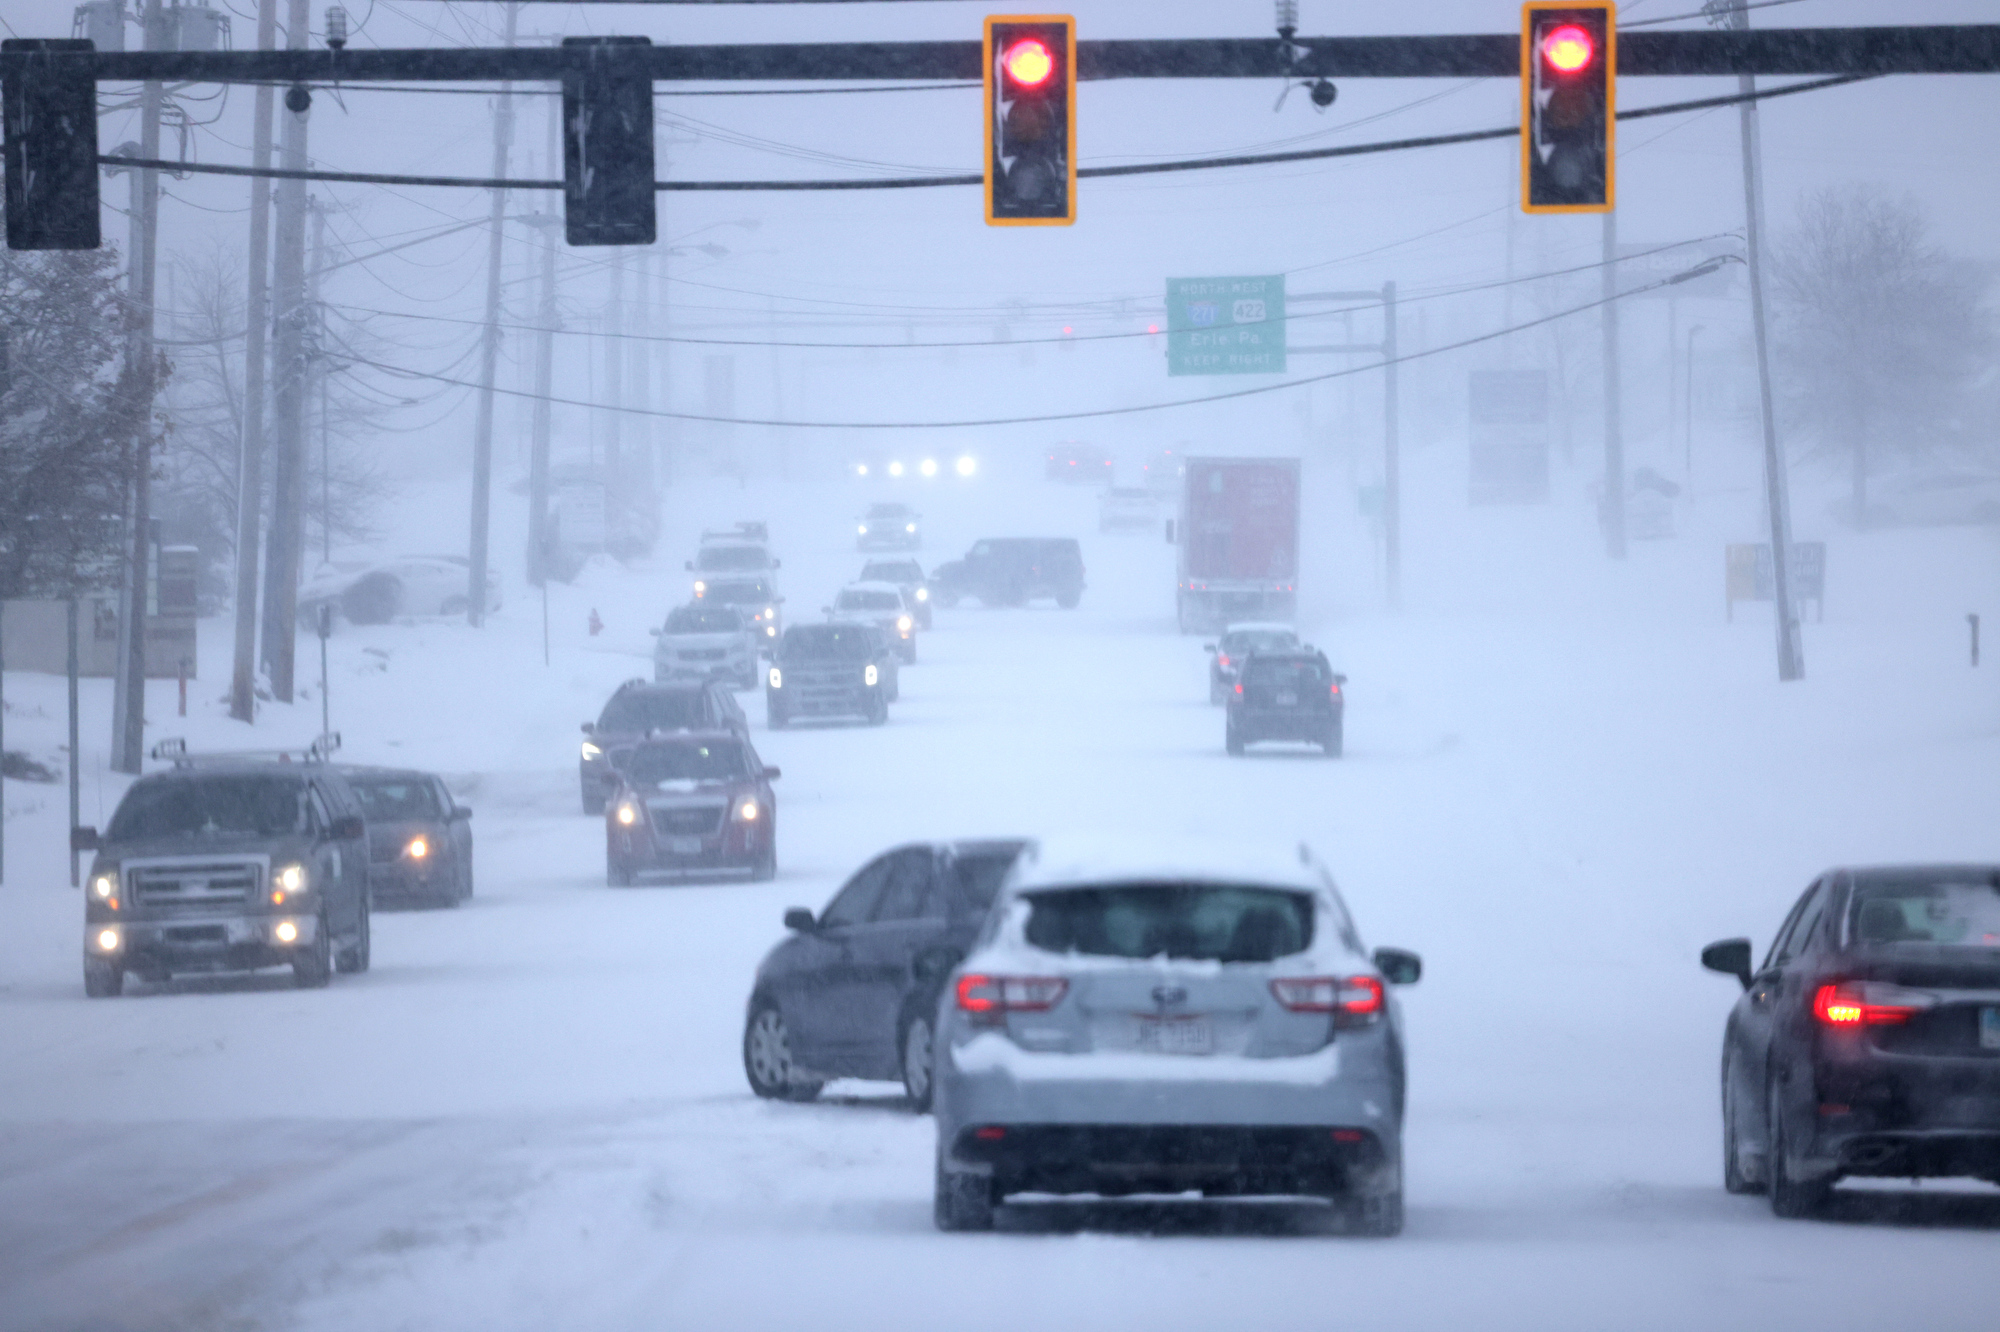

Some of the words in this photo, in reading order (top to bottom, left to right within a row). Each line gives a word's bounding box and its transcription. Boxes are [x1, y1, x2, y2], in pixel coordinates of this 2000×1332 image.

[1180, 283, 1225, 296] NORTH
[1231, 281, 1267, 294] WEST
[1192, 307, 1214, 321] 271
[1236, 304, 1264, 318] 422
[1191, 333, 1228, 346] Erie
[1239, 331, 1262, 345] Pa
[1184, 354, 1220, 366] KEEP
[1230, 352, 1271, 365] RIGHT
